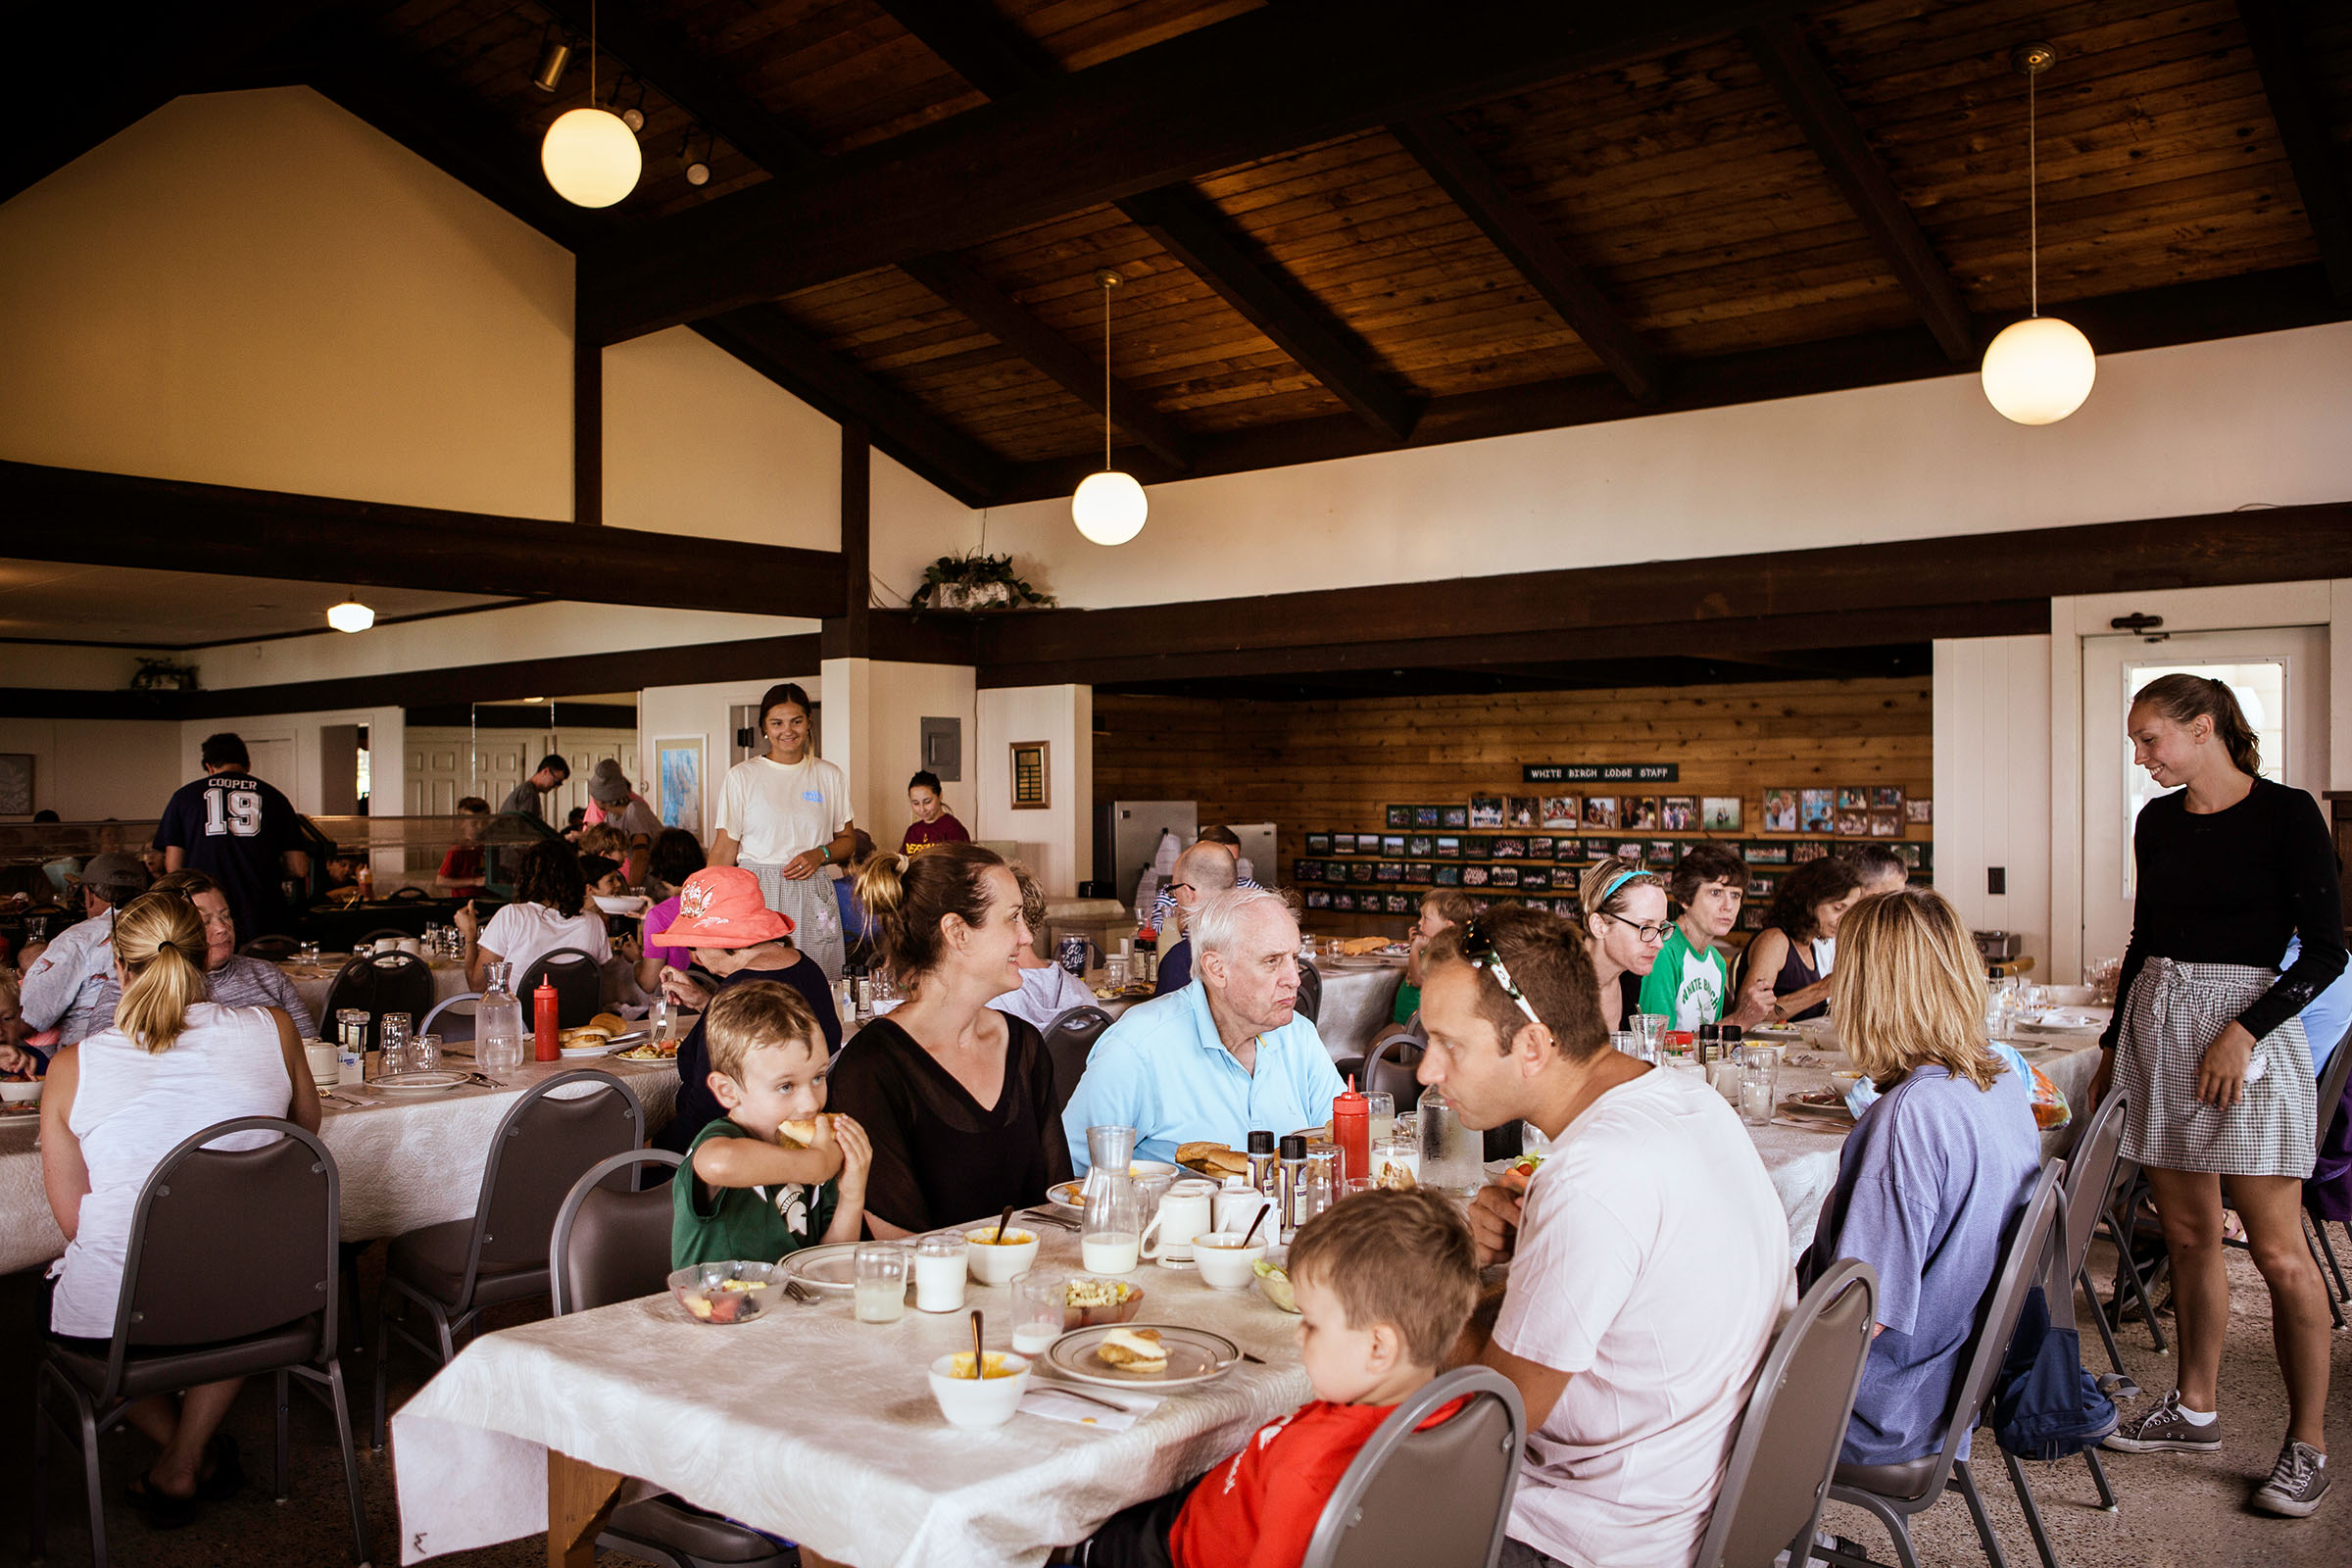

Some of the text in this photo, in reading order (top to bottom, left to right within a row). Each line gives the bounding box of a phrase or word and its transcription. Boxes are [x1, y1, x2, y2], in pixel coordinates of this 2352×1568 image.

[1531, 767, 1668, 779] WHITE BIRCH LODGE STAFF
[209, 778, 258, 790] COOPER
[204, 788, 263, 836] 19
[1067, 944, 1082, 955] GO
[1682, 978, 1702, 1004] WHITE
